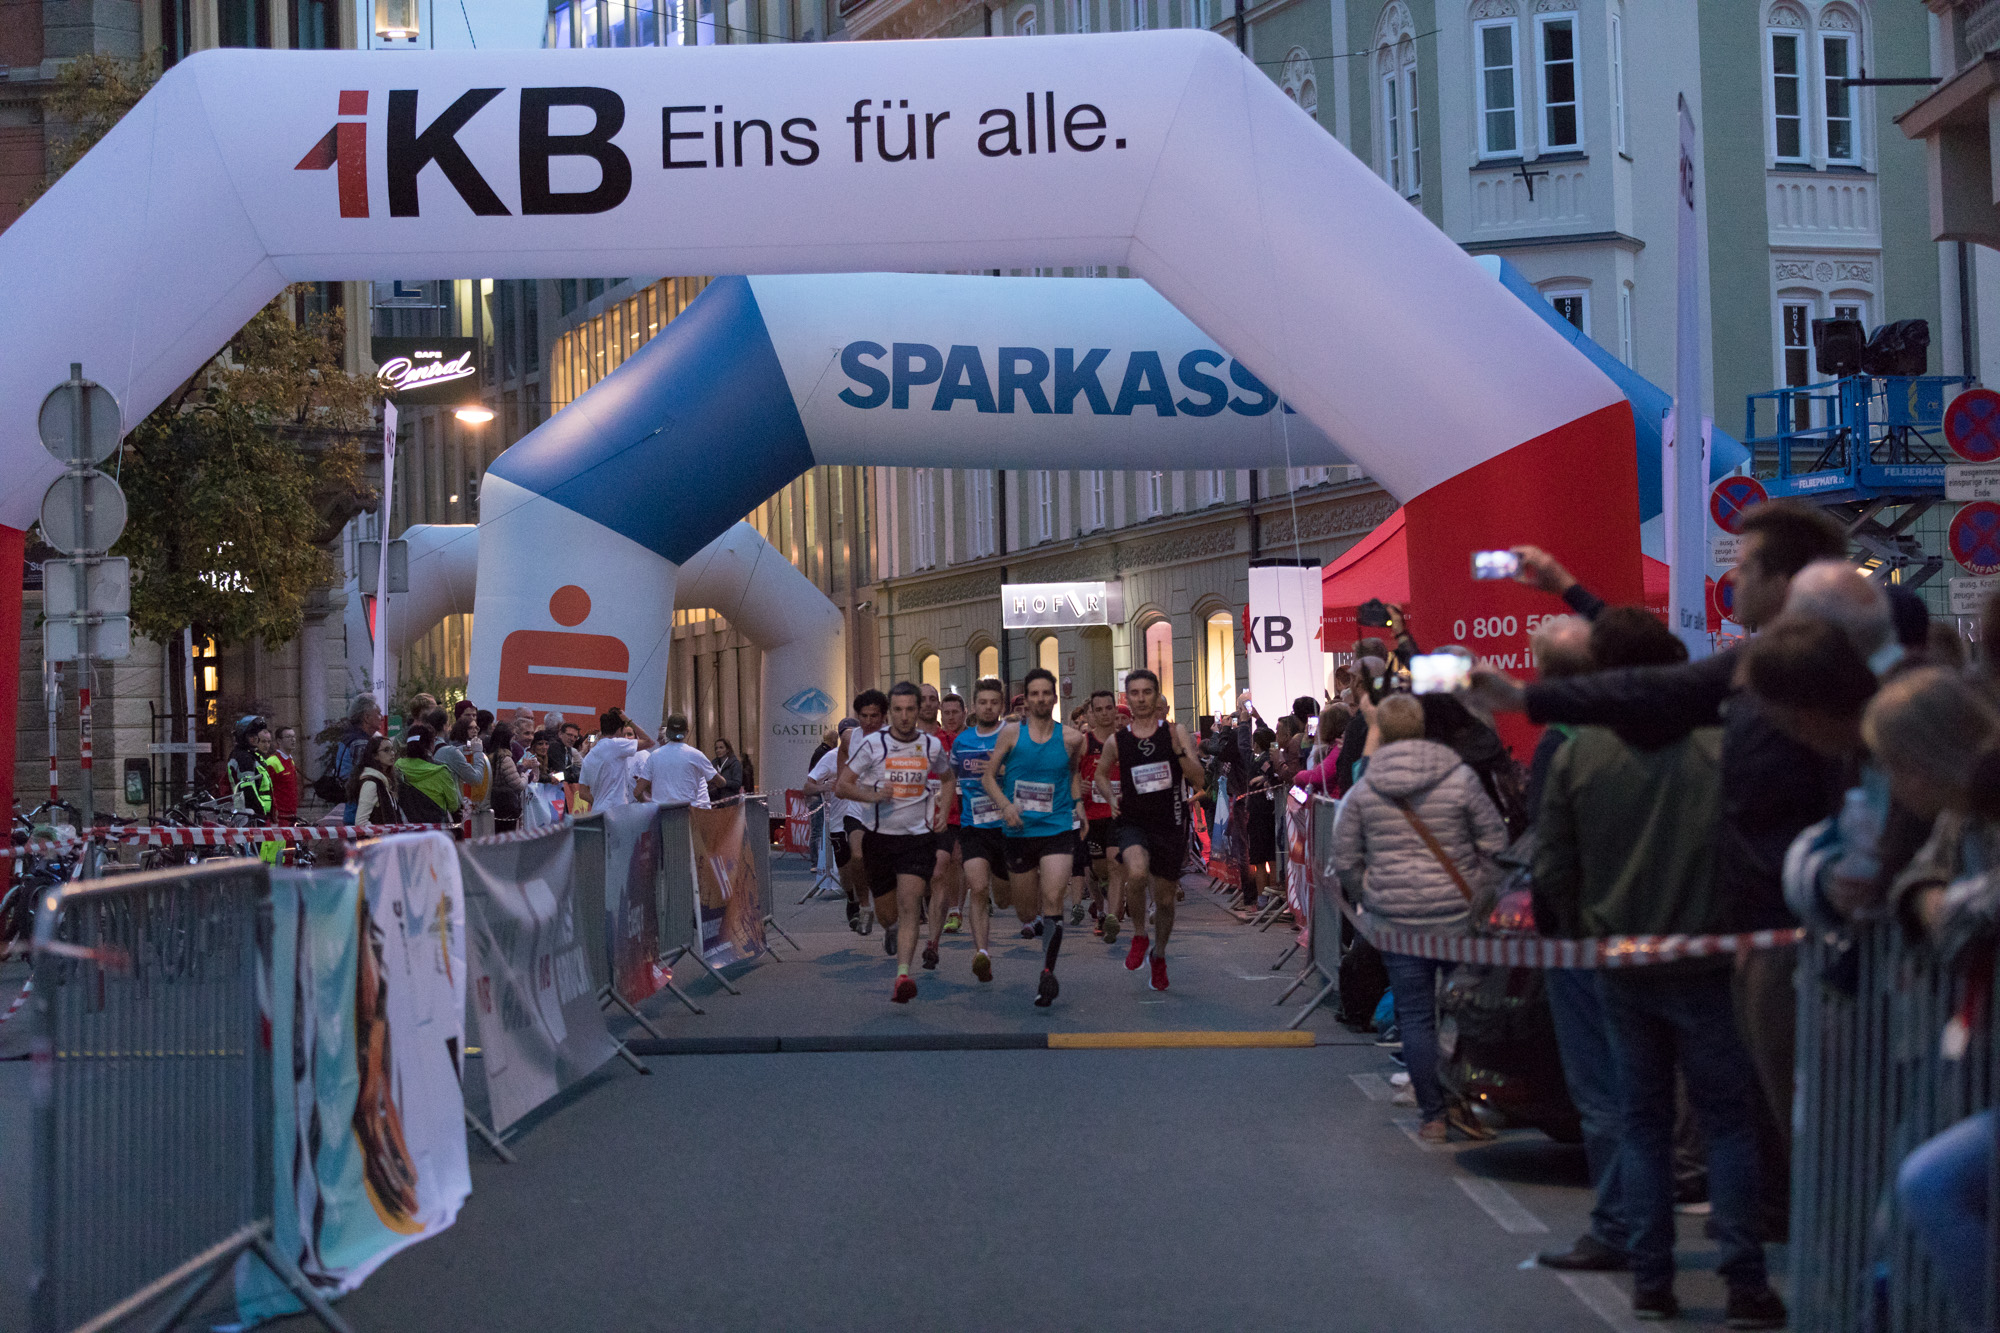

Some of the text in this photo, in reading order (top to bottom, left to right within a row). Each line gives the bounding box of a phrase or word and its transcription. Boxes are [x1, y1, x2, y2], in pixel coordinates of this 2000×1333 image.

[662, 104, 820, 169] Eins
[846, 98, 950, 163] für
[977, 91, 1127, 157] alle.
[837, 340, 1297, 417] SPARKASS
[1884, 467, 1945, 477] FELBERMAY
[1974, 489, 1990, 497] Ende
[1963, 560, 2000, 574] ANFAN
[1453, 620, 1466, 640] 0
[1473, 616, 1518, 639] 800
[890, 771, 922, 783] 66173
